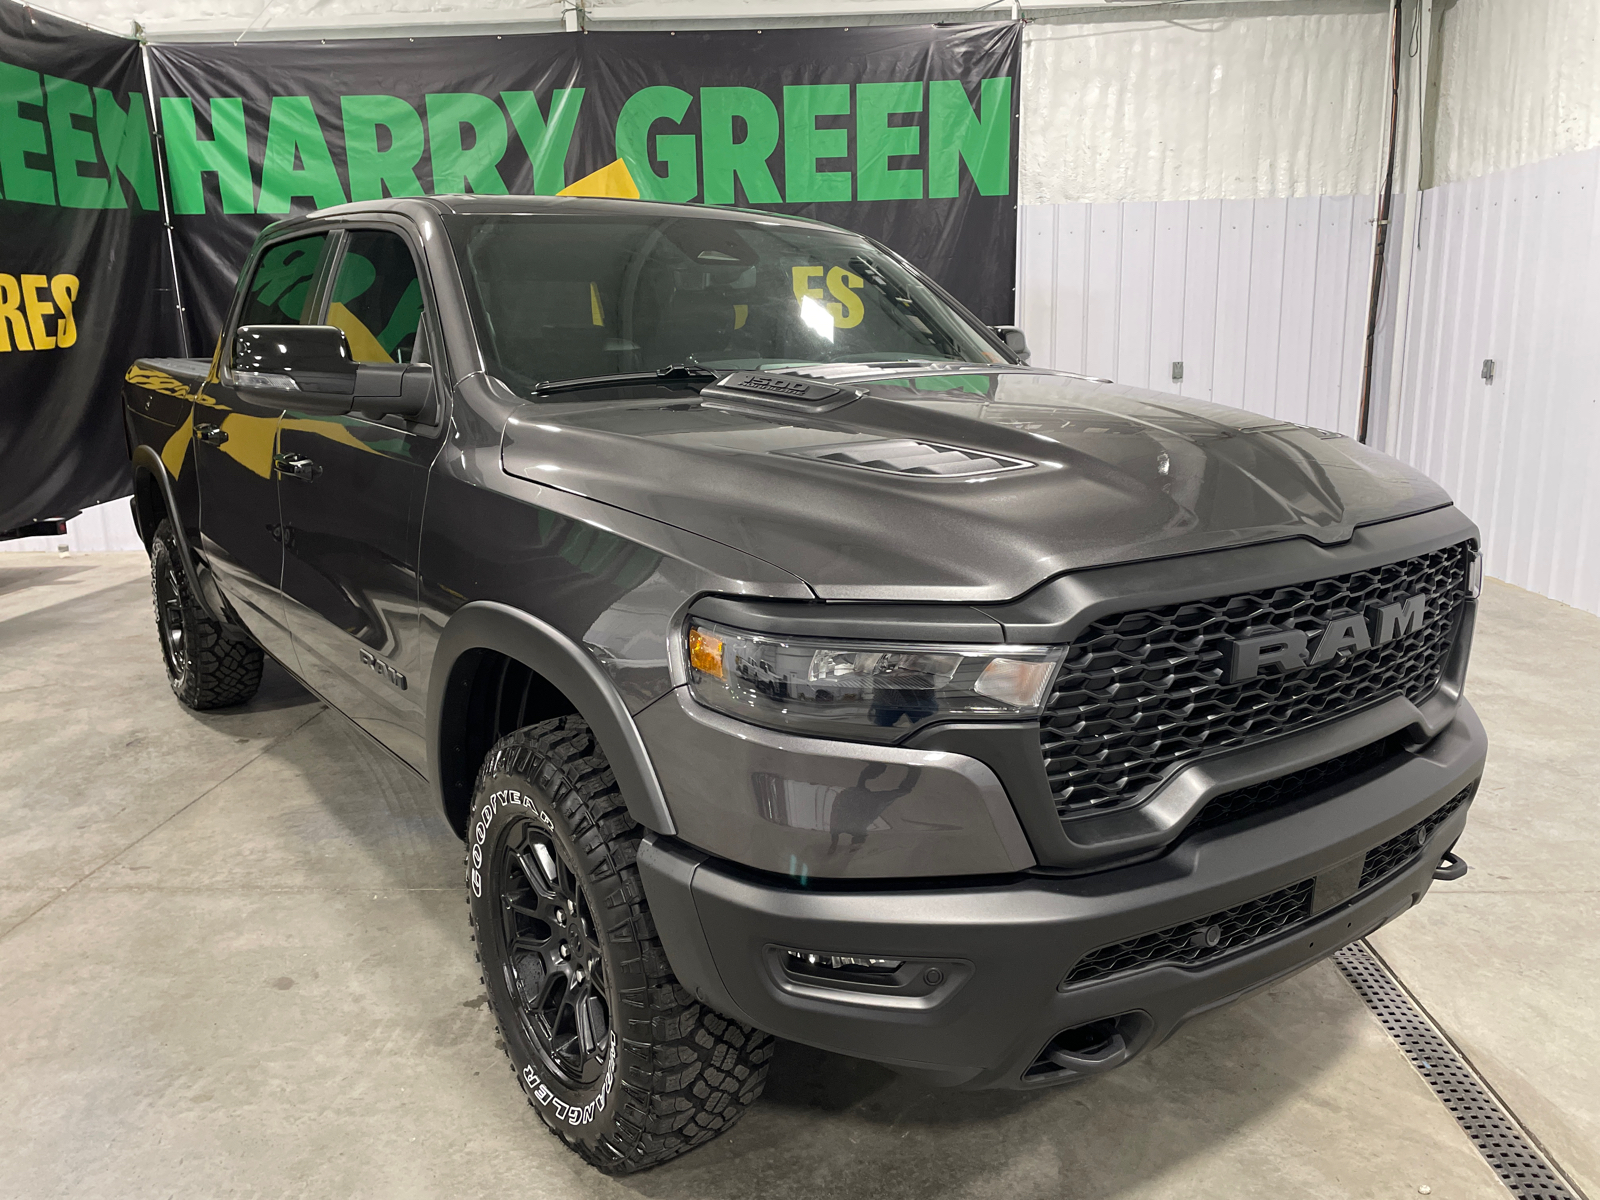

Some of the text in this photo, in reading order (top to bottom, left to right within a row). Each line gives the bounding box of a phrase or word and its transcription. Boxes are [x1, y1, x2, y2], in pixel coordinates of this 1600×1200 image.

[0, 61, 160, 212] EEN
[160, 76, 1012, 215] HARRY GREEN
[743, 375, 811, 392] 1500
[359, 648, 408, 690] RAM
[1229, 593, 1426, 684] RAM
[472, 790, 554, 897] GOODYEAR
[523, 1029, 617, 1125] WRANGLER
